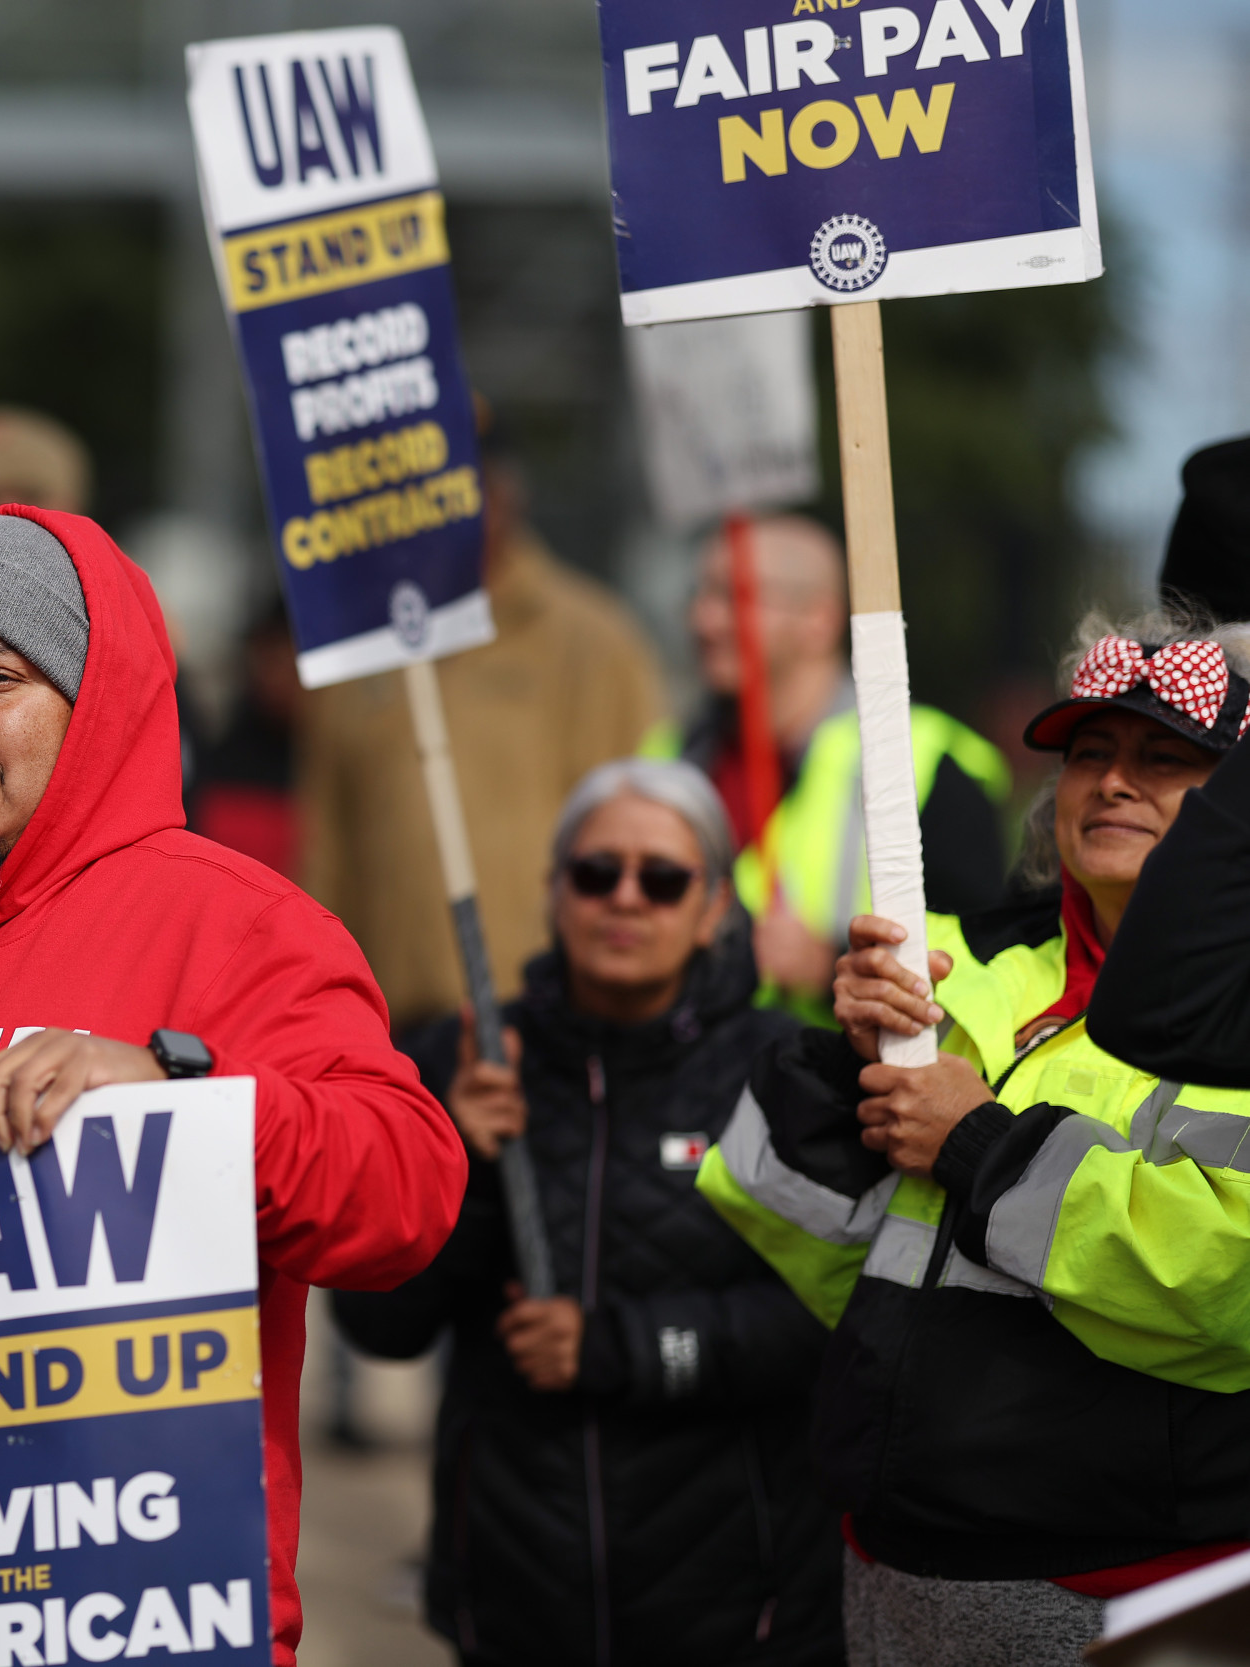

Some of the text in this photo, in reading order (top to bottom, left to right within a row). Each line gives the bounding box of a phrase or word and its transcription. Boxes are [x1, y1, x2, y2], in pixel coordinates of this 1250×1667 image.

[623, 0, 1037, 116] FAIR PAY
[230, 54, 385, 188] UAW
[717, 82, 956, 184] NOW
[242, 226, 373, 293] STAND
[831, 241, 863, 262] UAW
[281, 302, 429, 386] RECORD
[290, 355, 439, 442] PROFITS
[303, 421, 448, 506] RECORD
[281, 465, 482, 571] CONTRACTS
[116, 1329, 229, 1397] UP
